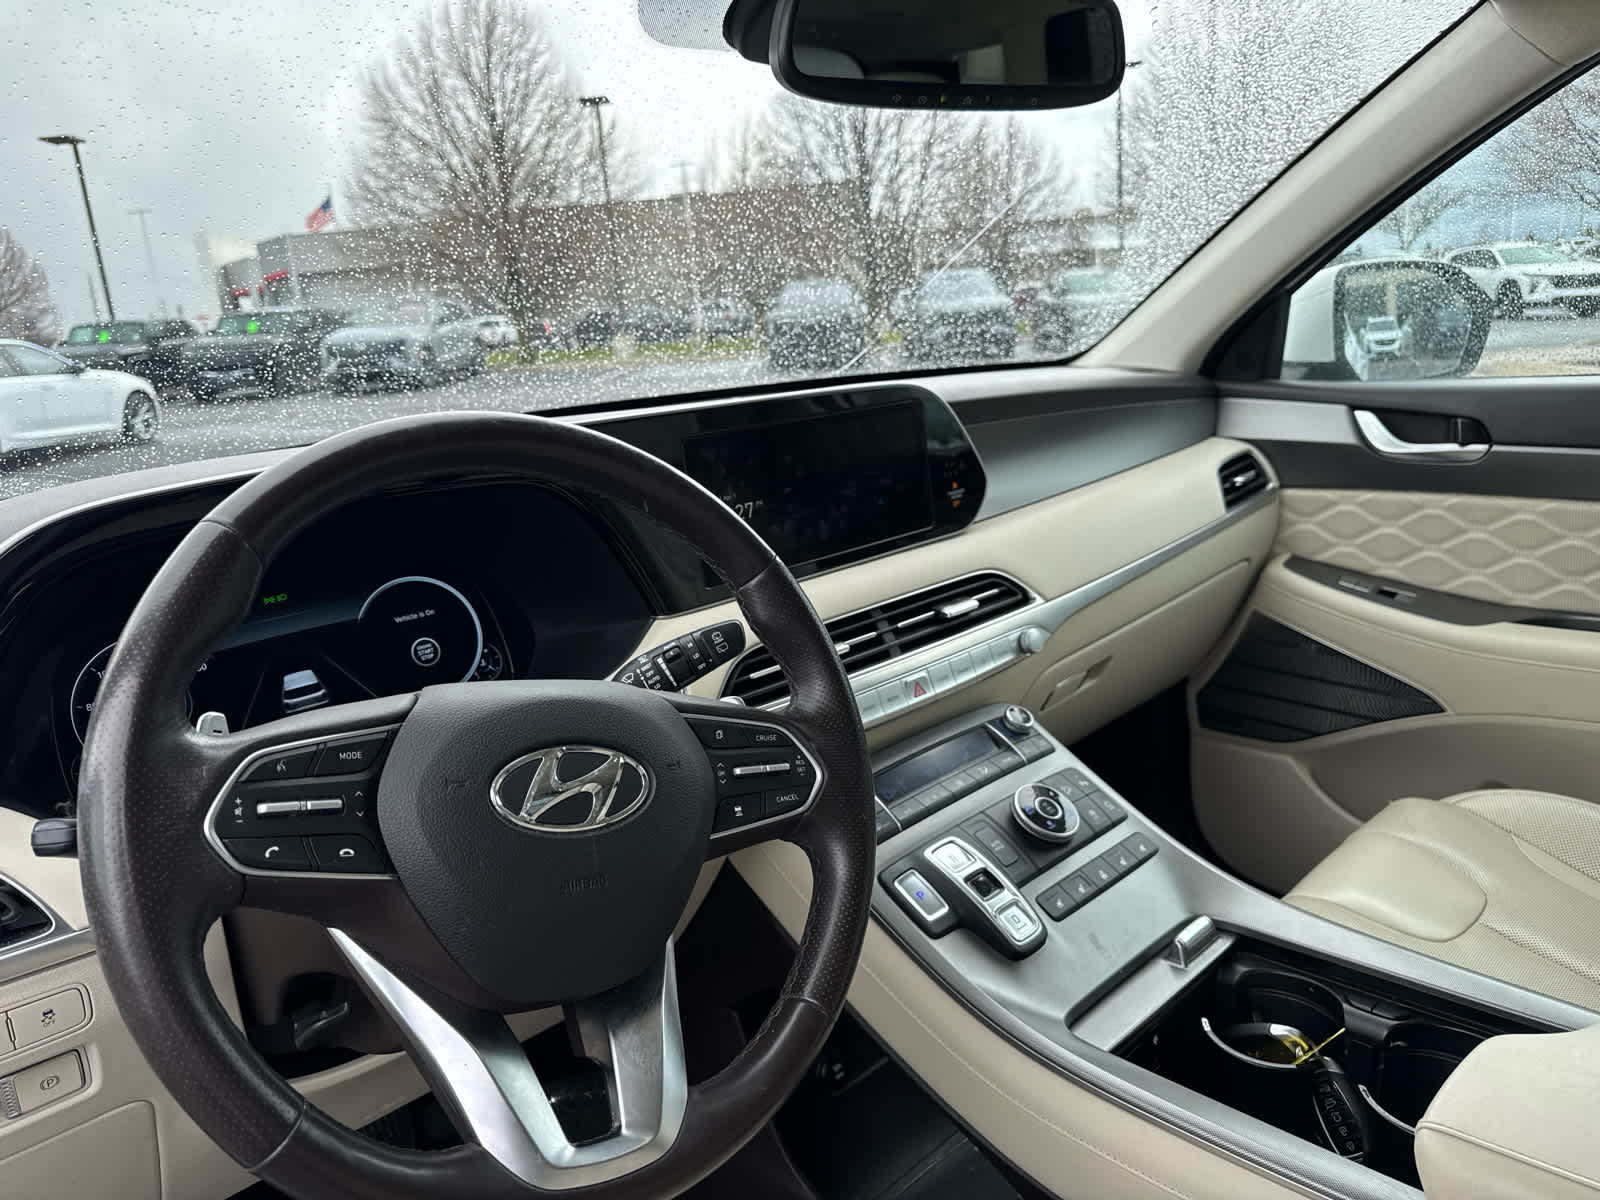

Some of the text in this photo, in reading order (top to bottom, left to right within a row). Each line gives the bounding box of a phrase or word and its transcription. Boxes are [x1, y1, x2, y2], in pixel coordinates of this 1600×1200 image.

[755, 734, 777, 742] CRUISE
[339, 751, 363, 760] MODE
[776, 793, 800, 803] CANCEL
